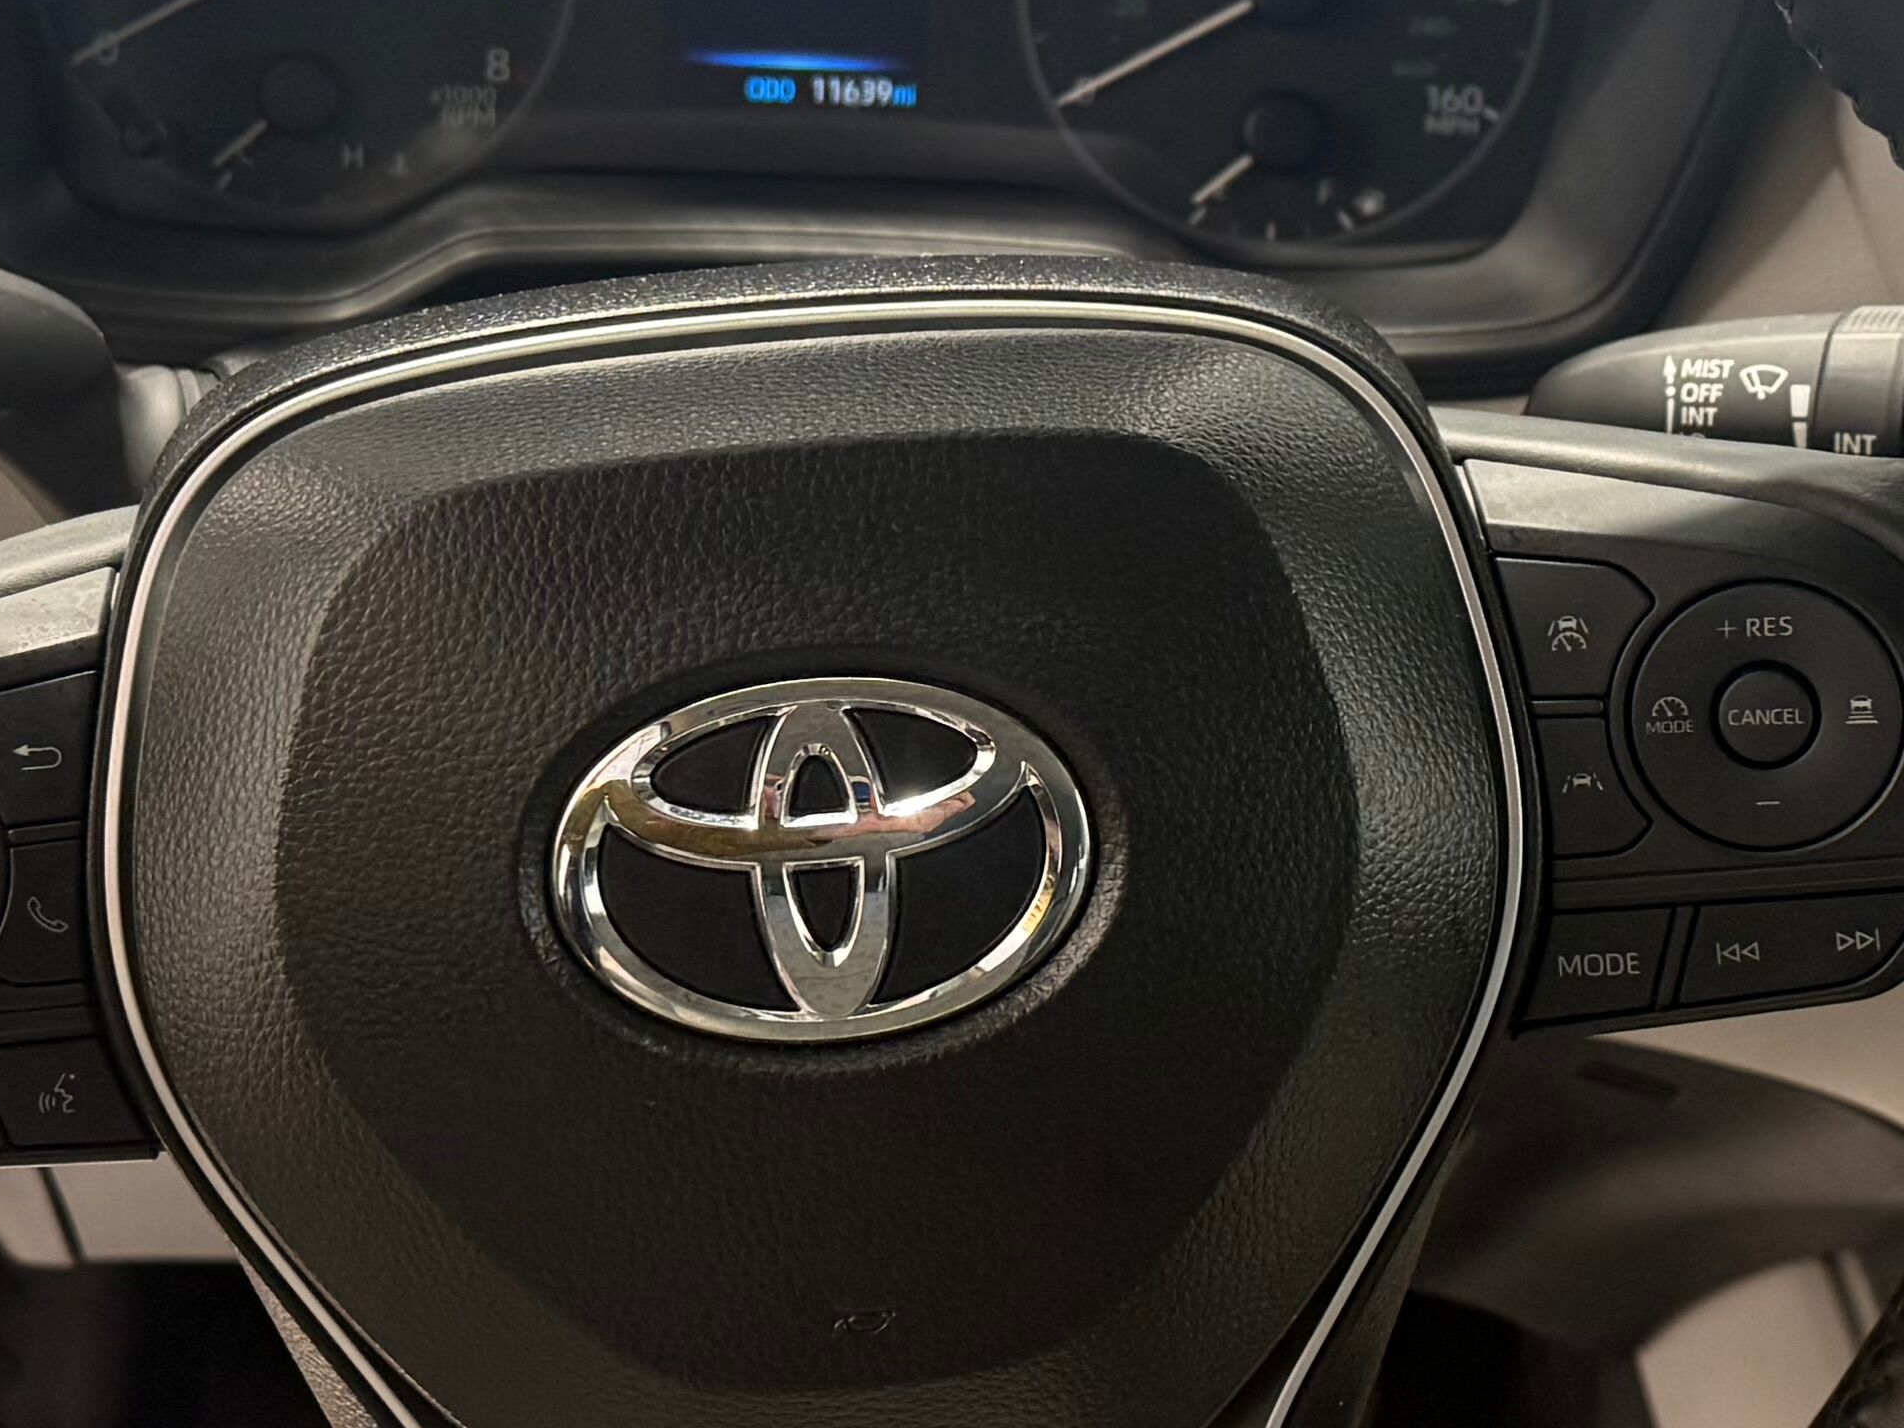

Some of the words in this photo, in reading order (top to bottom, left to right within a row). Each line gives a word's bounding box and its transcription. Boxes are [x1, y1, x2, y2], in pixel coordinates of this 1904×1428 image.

[486, 47, 511, 82] 8
[1425, 83, 1484, 114] 160
[342, 144, 364, 168] H
[1680, 358, 1735, 379] MIST
[1679, 382, 1724, 404] OFF
[1680, 406, 1718, 427] INT
[1833, 431, 1878, 456] INT
[1745, 616, 1794, 638] RES
[1645, 717, 1695, 735] MODE
[1727, 707, 1805, 727] CANCEL
[1557, 951, 1641, 978] MODE
